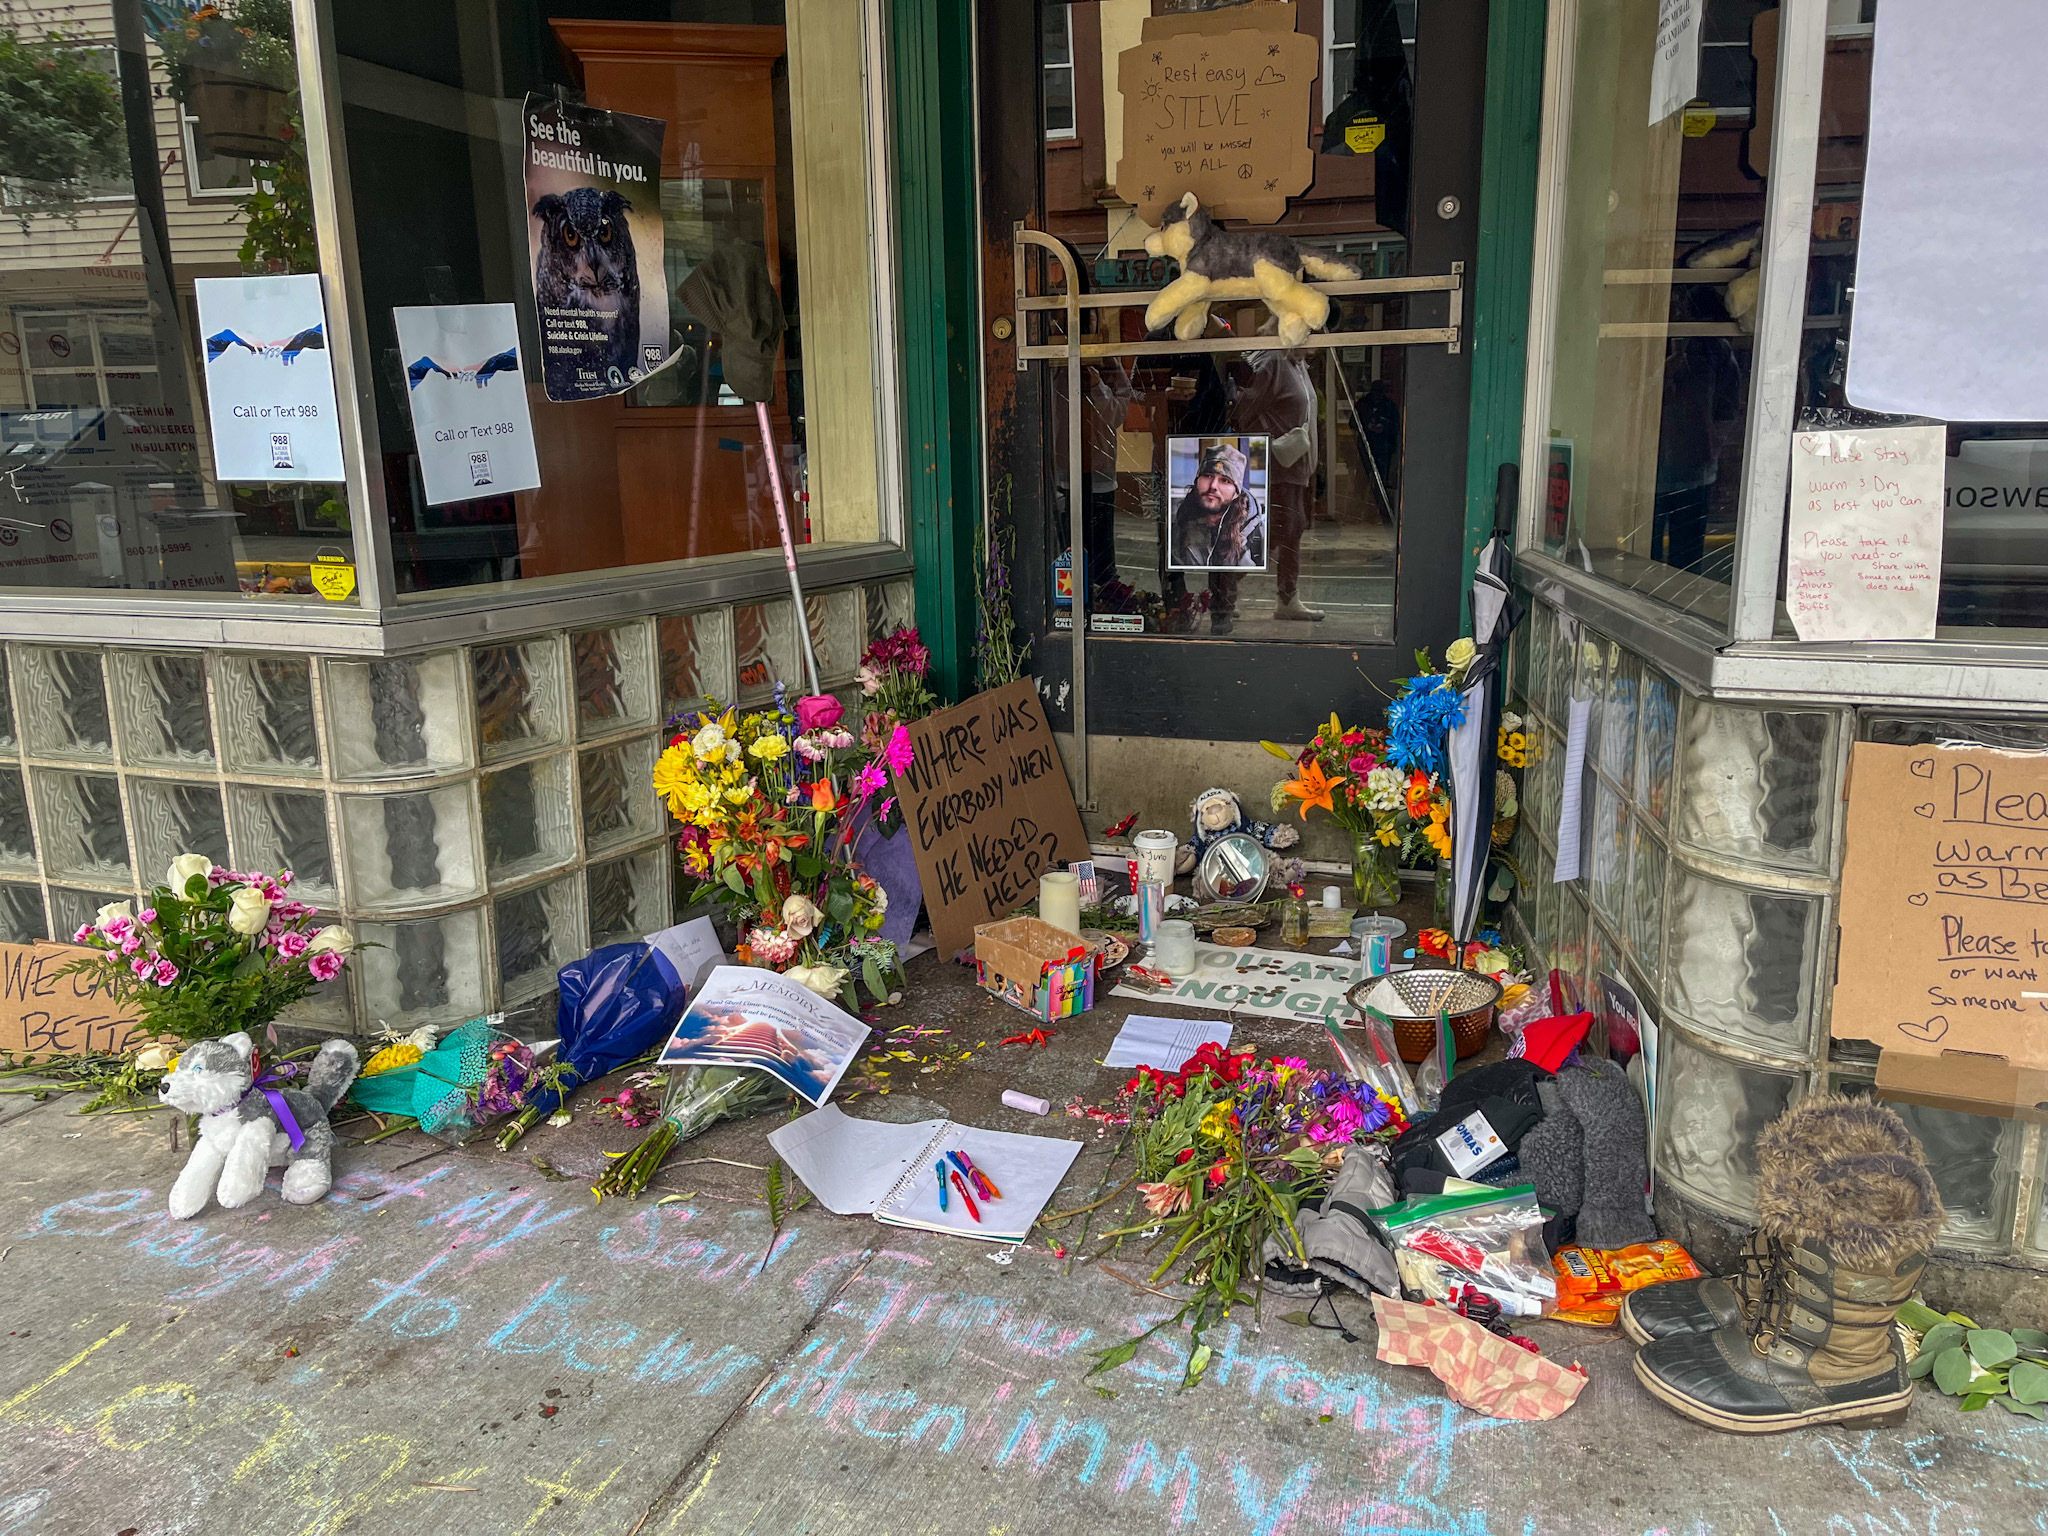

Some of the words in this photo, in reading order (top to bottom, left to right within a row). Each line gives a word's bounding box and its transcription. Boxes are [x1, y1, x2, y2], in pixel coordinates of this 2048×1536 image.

[1164, 64, 1197, 82] Rest
[1206, 67, 1246, 90] easy
[1156, 93, 1251, 130] STEVE
[530, 113, 555, 141] See
[557, 122, 581, 147] the
[1161, 147, 1176, 161] you
[1181, 141, 1197, 153] will
[1204, 142, 1214, 151] be
[1220, 137, 1252, 150] missed
[531, 142, 595, 175] beautiful
[597, 154, 611, 177] in
[613, 162, 648, 183] you.
[1174, 160, 1192, 175] BY
[1200, 158, 1228, 171] ALL
[82, 266, 148, 281] INSULATION
[544, 306, 560, 316] Need
[560, 308, 579, 317] mental
[578, 308, 596, 318] health
[596, 309, 619, 319] support?
[546, 319, 557, 328] Call
[557, 320, 564, 328] or
[564, 320, 576, 329] text
[575, 320, 588, 330] 988,
[546, 331, 568, 340] Suicide
[568, 332, 574, 340] &
[574, 332, 589, 341] Crisis
[589, 332, 609, 342] Lifeline
[645, 349, 661, 360] 988
[576, 367, 598, 380] Trust
[233, 405, 258, 417] Call
[260, 408, 272, 417] or
[273, 405, 296, 417] Text
[298, 405, 318, 417] 988
[125, 425, 195, 435] ENGINEERED
[435, 429, 455, 442] Call
[457, 430, 469, 440] or
[470, 425, 493, 437] Text
[494, 422, 515, 435] 988
[131, 442, 196, 452] INSULATION
[272, 435, 288, 445] 988
[471, 454, 487, 464] 988
[1874, 475, 1900, 496] Dry
[1808, 500, 1821, 511] as
[1834, 499, 1860, 511] best
[1872, 499, 1893, 512] you
[1804, 531, 1848, 549] Please
[1859, 535, 1888, 547] take
[1800, 568, 1826, 577] Hats
[1904, 562, 1929, 570] with
[172, 576, 225, 589] PREMIUM
[1799, 580, 1833, 589] Gloves
[1800, 592, 1829, 600] Shoes
[1799, 602, 1829, 611] Buffs
[904, 715, 987, 794] WHERE
[992, 699, 1038, 744] WAS
[1008, 745, 1053, 787] WHEN
[1200, 790, 1221, 801] ALASKA
[936, 849, 968, 906] HE
[967, 817, 1038, 882] NEEDED
[1941, 915, 2017, 956] Please
[1196, 950, 1273, 972] OU
[5, 950, 70, 1002] WE
[1950, 968, 1976, 979] or
[750, 980, 822, 1019] MEMORY
[1609, 991, 1626, 1019] You
[20, 1011, 160, 1053] BETTE
[1457, 1123, 1483, 1156] OMBAS
[1426, 1229, 1471, 1250] olgate
[361, 1256, 461, 1338] to
